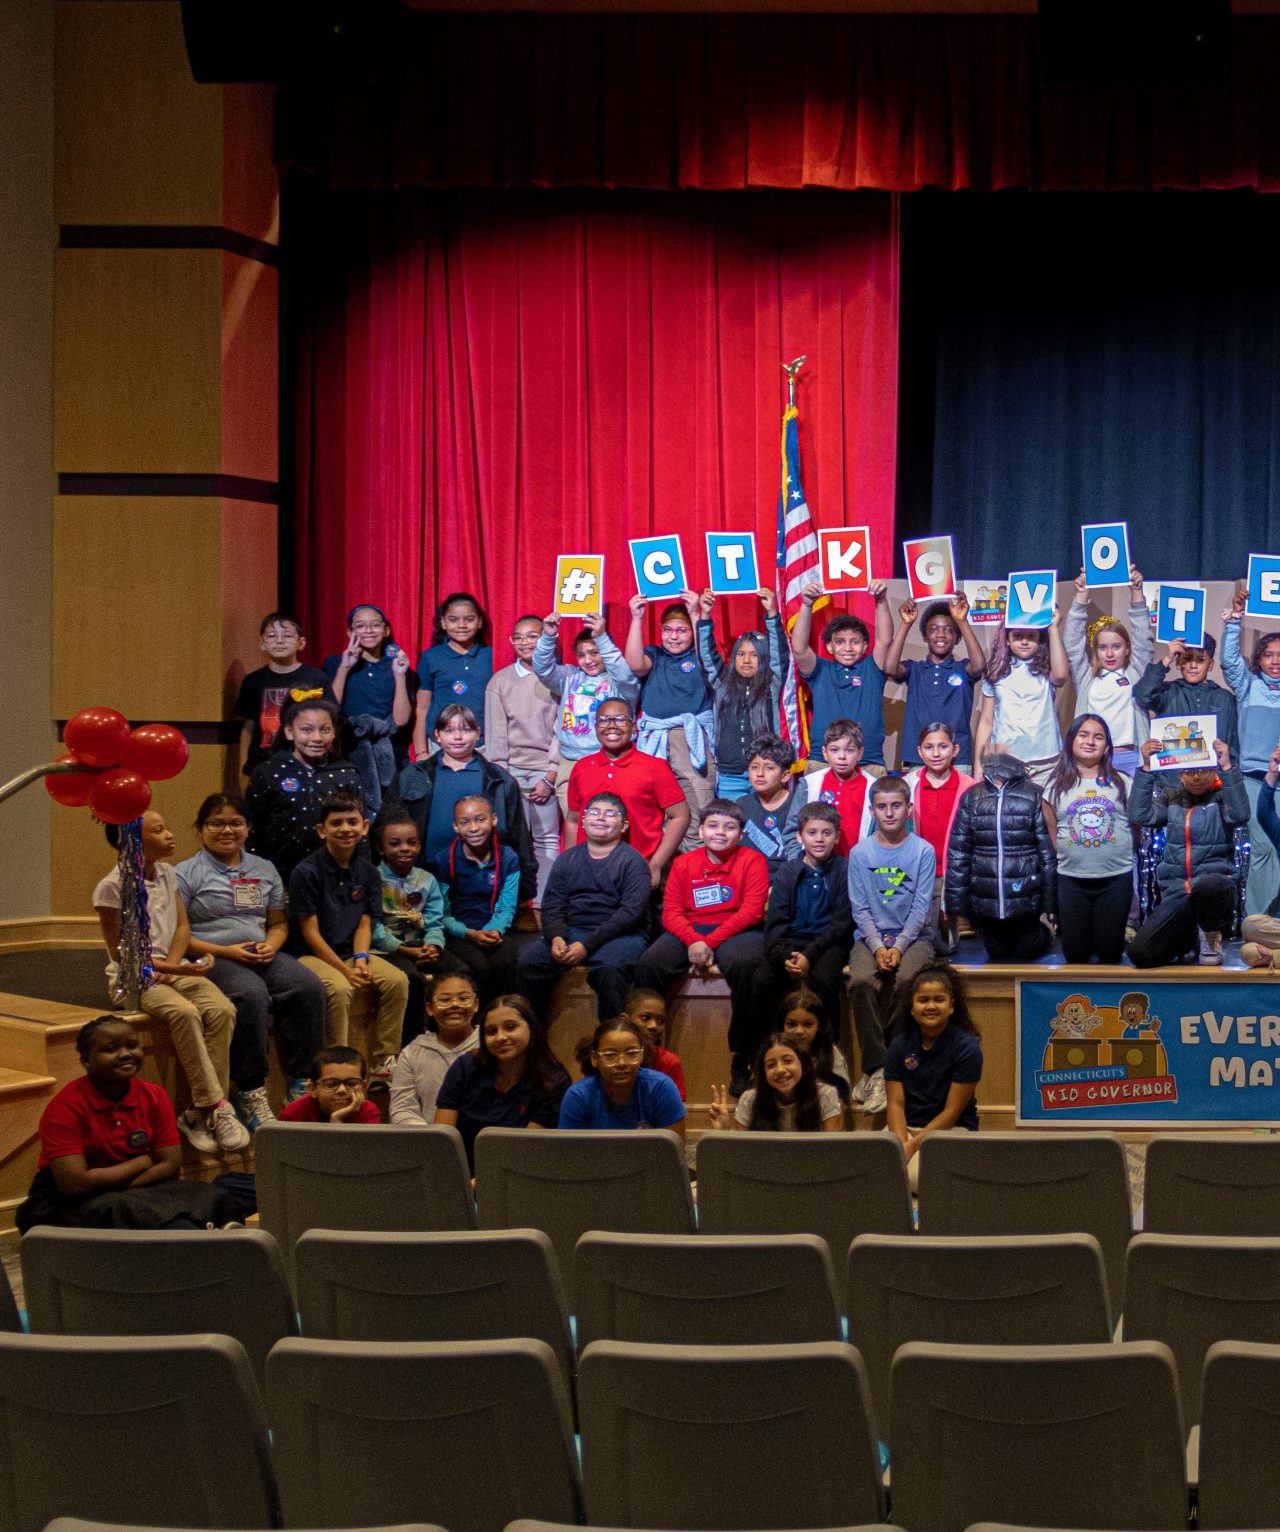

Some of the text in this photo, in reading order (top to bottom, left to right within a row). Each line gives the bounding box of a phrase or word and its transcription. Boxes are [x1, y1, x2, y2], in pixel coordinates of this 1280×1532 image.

[643, 551, 676, 585] C
[716, 544, 745, 580] T
[826, 540, 862, 580] K
[914, 550, 944, 585] G
[559, 568, 597, 604] #
[1014, 580, 1049, 614] V
[1168, 597, 1195, 632] T
[1039, 1067, 1125, 1084] CONNECTICUT'S
[1046, 1081, 1173, 1103] KID GOVERNOR
